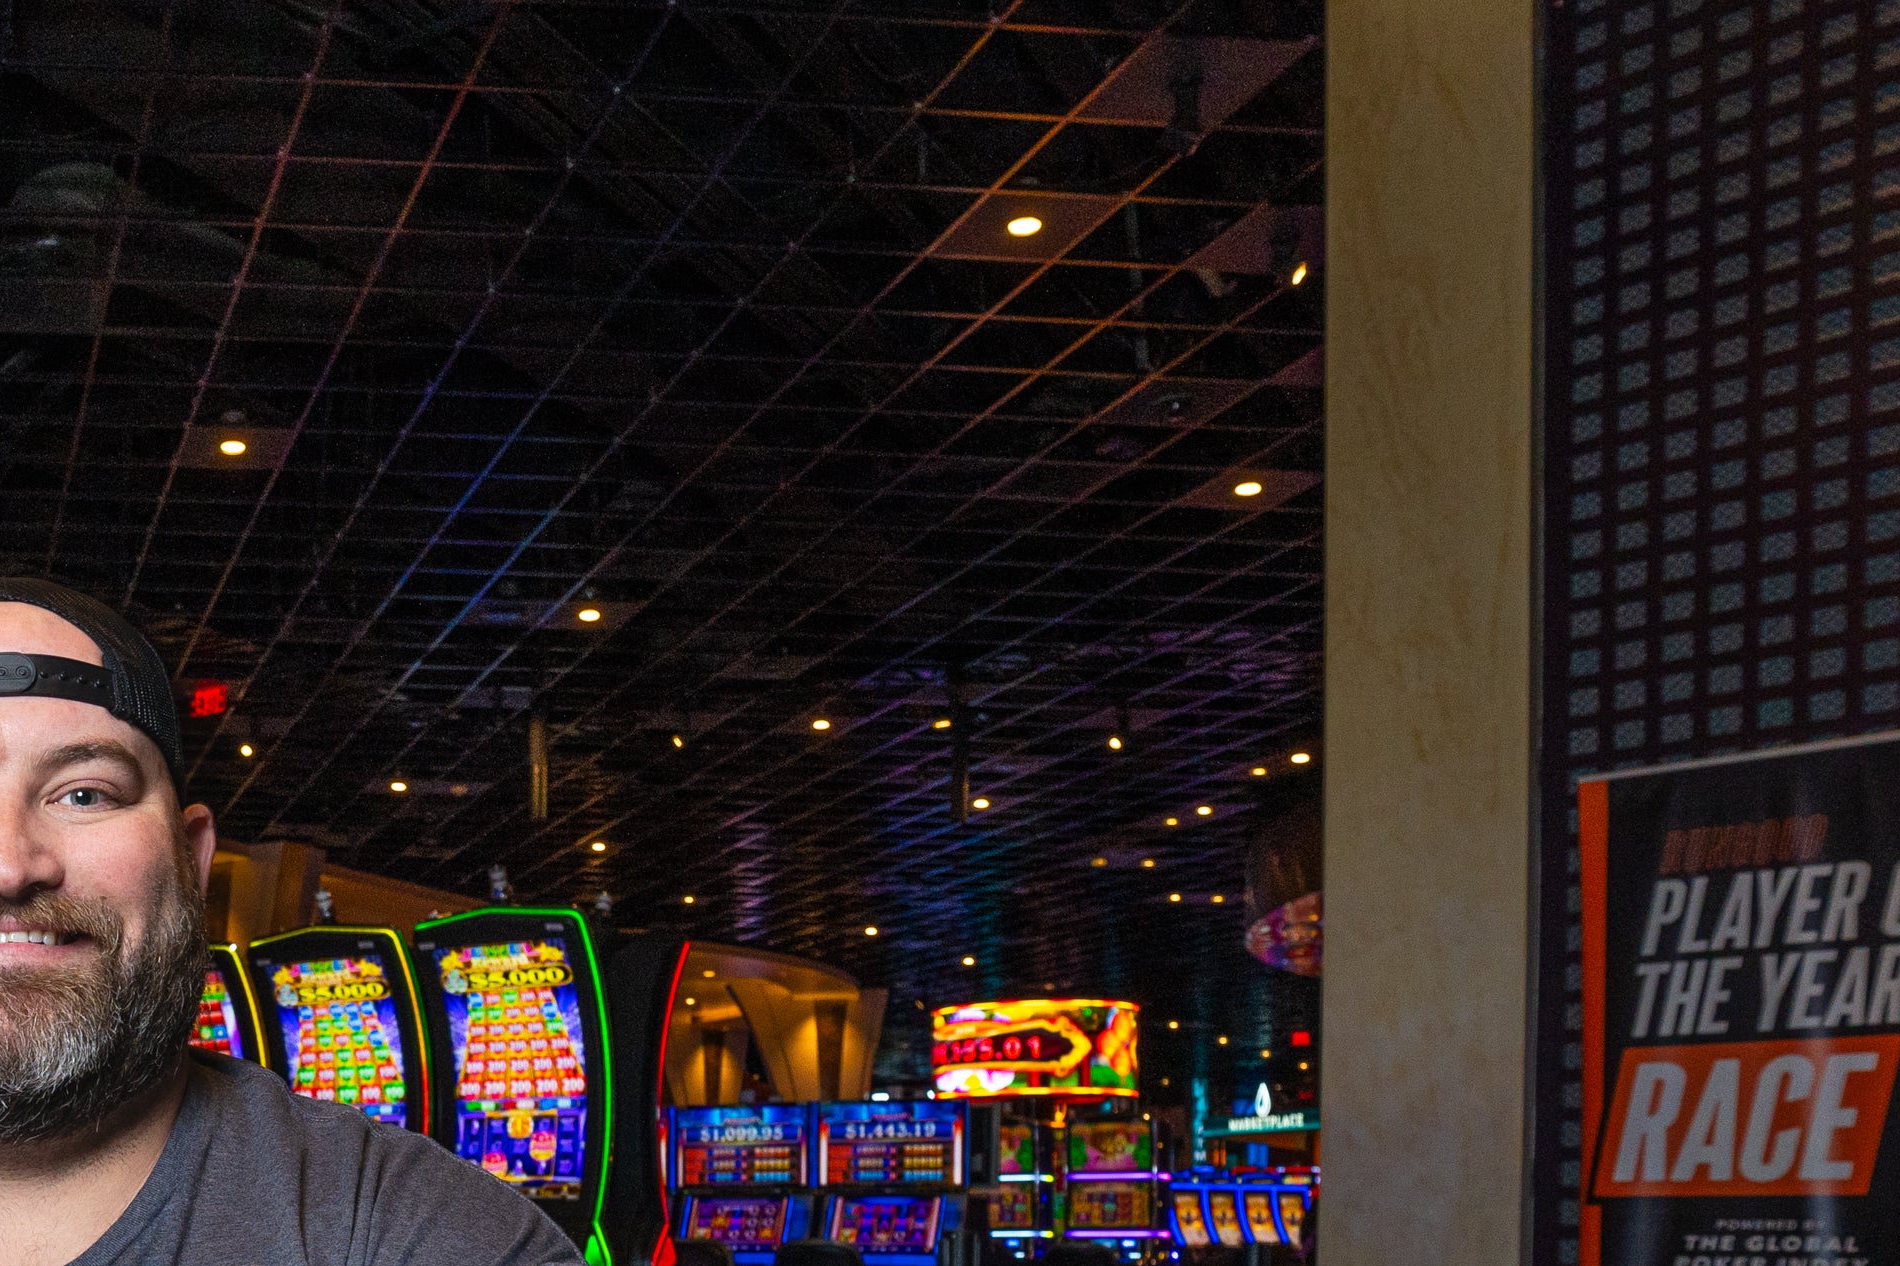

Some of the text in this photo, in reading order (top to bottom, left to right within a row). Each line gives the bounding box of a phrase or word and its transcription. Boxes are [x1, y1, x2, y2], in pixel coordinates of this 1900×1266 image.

[1641, 860, 1872, 957] PLAYER
[1631, 944, 1900, 1038] THE YEAR
[1612, 1053, 1880, 1183] RACE
[1684, 1234, 1860, 1253] THE GLOBAL
